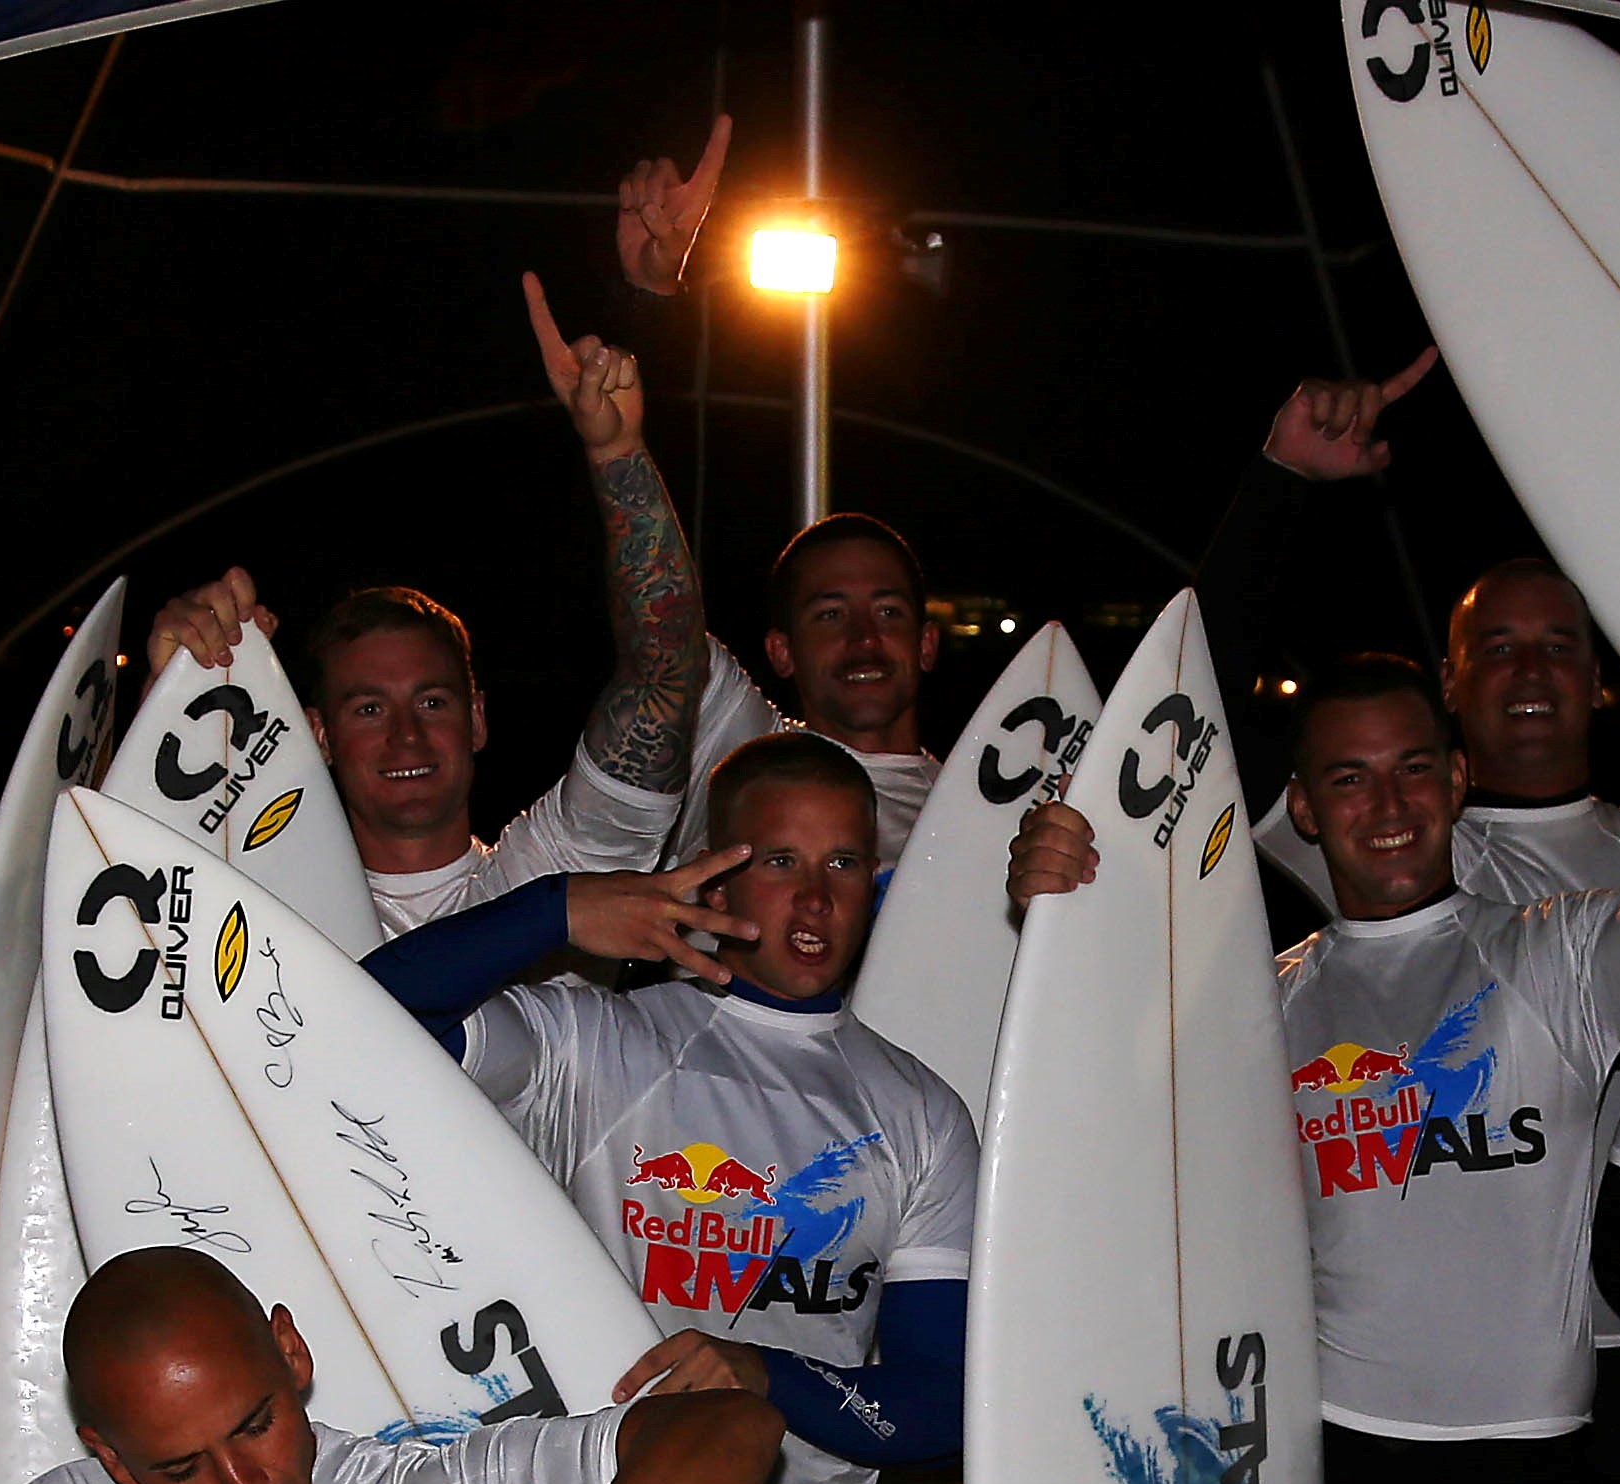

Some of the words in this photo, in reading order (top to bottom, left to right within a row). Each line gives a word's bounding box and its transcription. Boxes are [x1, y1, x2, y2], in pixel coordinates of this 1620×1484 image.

[1429, 0, 1459, 97] QUIVE
[198, 717, 292, 835] QUIVER
[1030, 719, 1095, 807] UIVER
[1152, 720, 1220, 851] QUIVER
[160, 864, 196, 1021] QUIVER
[1313, 1104, 1548, 1199] RIVALS
[1349, 1085, 1421, 1133] Bull
[621, 1198, 694, 1247] Red
[697, 1206, 776, 1257] Bull
[640, 1236, 880, 1318] RIVALS
